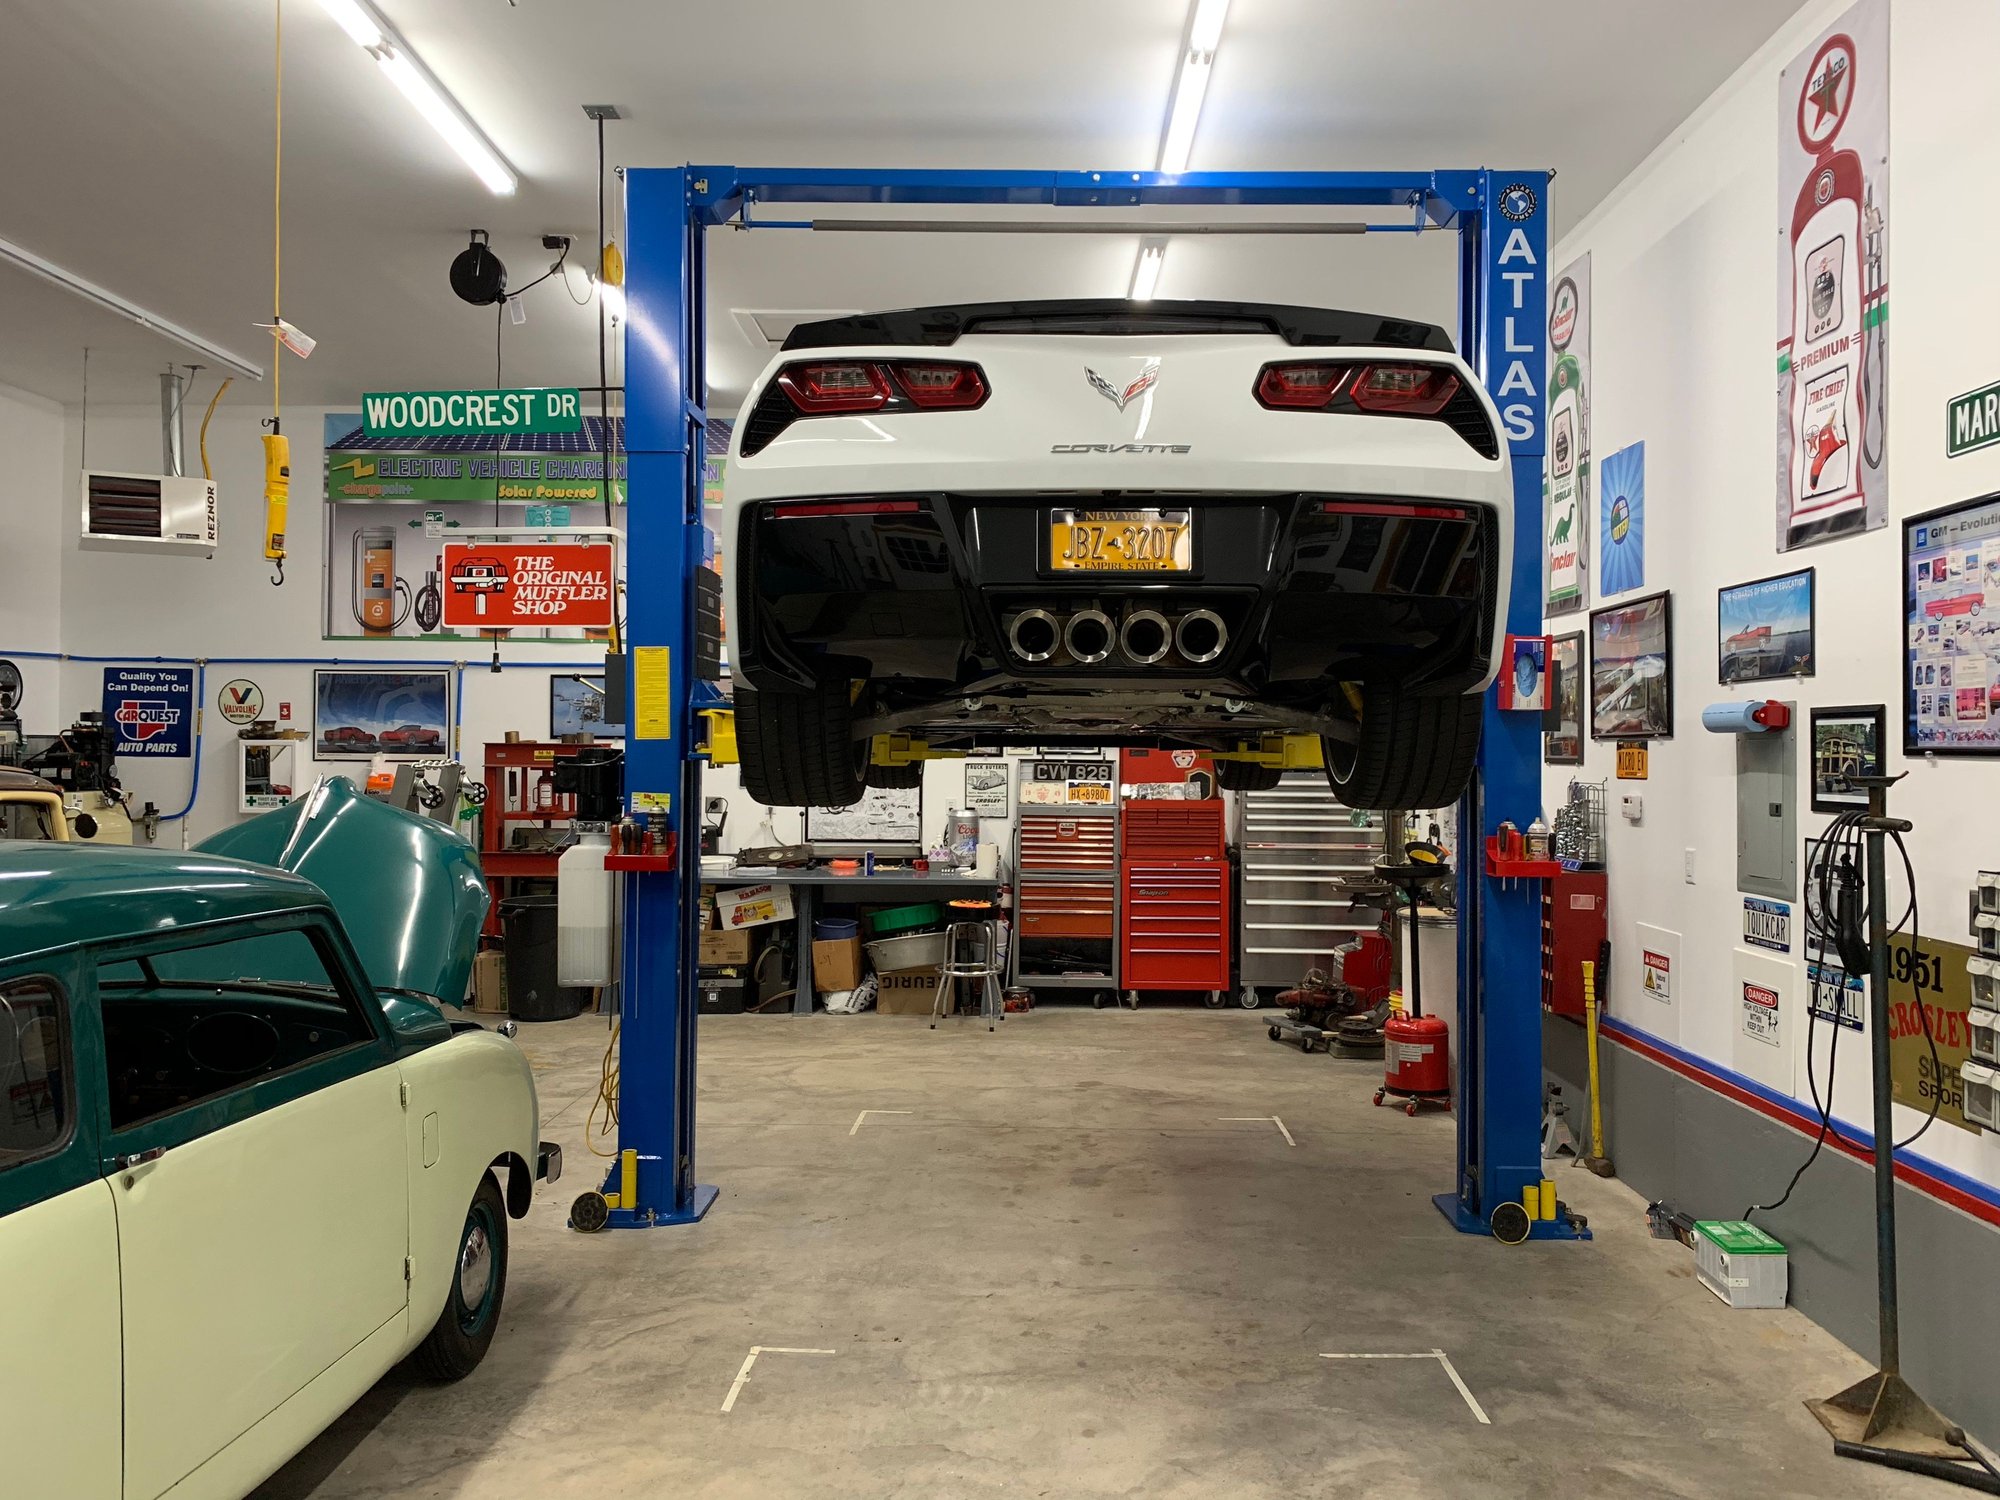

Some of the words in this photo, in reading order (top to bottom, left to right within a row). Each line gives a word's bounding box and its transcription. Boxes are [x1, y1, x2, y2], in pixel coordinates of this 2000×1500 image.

[1506, 184, 1530, 195] ATLAS
[1500, 203, 1535, 220] EQUIPMENT
[1498, 228, 1537, 441] ATLAS
[1800, 336, 1849, 371] PREMIUM
[1808, 388, 1824, 406] FIRE
[1825, 378, 1845, 398] CHIEF
[366, 394, 535, 429] WOODCREST
[547, 393, 576, 417] DR
[1956, 393, 2000, 445] MAR
[1050, 444, 1192, 454] CORVETTE
[378, 458, 462, 478] ELECTRIC
[468, 459, 541, 479] VEHICLE
[498, 485, 533, 498] Solar
[536, 485, 598, 499] Powered
[207, 486, 215, 540] REZNOR
[1086, 512, 1119, 521] NEW
[1931, 525, 1948, 538] GM
[1063, 526, 1106, 560] JBZ
[1123, 526, 1179, 560] 3207
[513, 556, 554, 571] THE
[1084, 561, 1124, 570] EMPIRE
[1127, 561, 1159, 570] STATE
[513, 570, 607, 585] ORIGINAL
[513, 585, 608, 600] MUFFLER
[1723, 593, 1732, 601] THE
[1732, 588, 1754, 601] REWARDS
[1760, 583, 1778, 594] HIGHER
[1778, 576, 1807, 590] EDUCATION
[512, 601, 567, 615] SHOP
[119, 672, 156, 682] Quality
[158, 673, 178, 681] You
[107, 683, 128, 691] Can
[130, 683, 168, 693] Depend
[171, 684, 189, 692] On!
[115, 709, 179, 723] CARQUEST
[223, 703, 257, 715] VALVOLINE
[117, 742, 143, 752] AUTO
[145, 743, 177, 753] PARTS
[1036, 764, 1070, 779] CVW
[1075, 765, 1109, 780] 828
[1071, 789, 1081, 800] HX
[1085, 789, 1109, 801] 89807
[1746, 910, 1786, 943] 1QUIKCAR
[1650, 955, 1668, 969] DANGER
[1747, 988, 1773, 1005] DANGER
[1743, 1002, 1752, 1010] HIGH
[1752, 1005, 1769, 1017] VOLTAGE
[1749, 1013, 1762, 1023] WITHIN
[1747, 1020, 1756, 1031] KEEP
[1756, 1024, 1765, 1034] OUT
